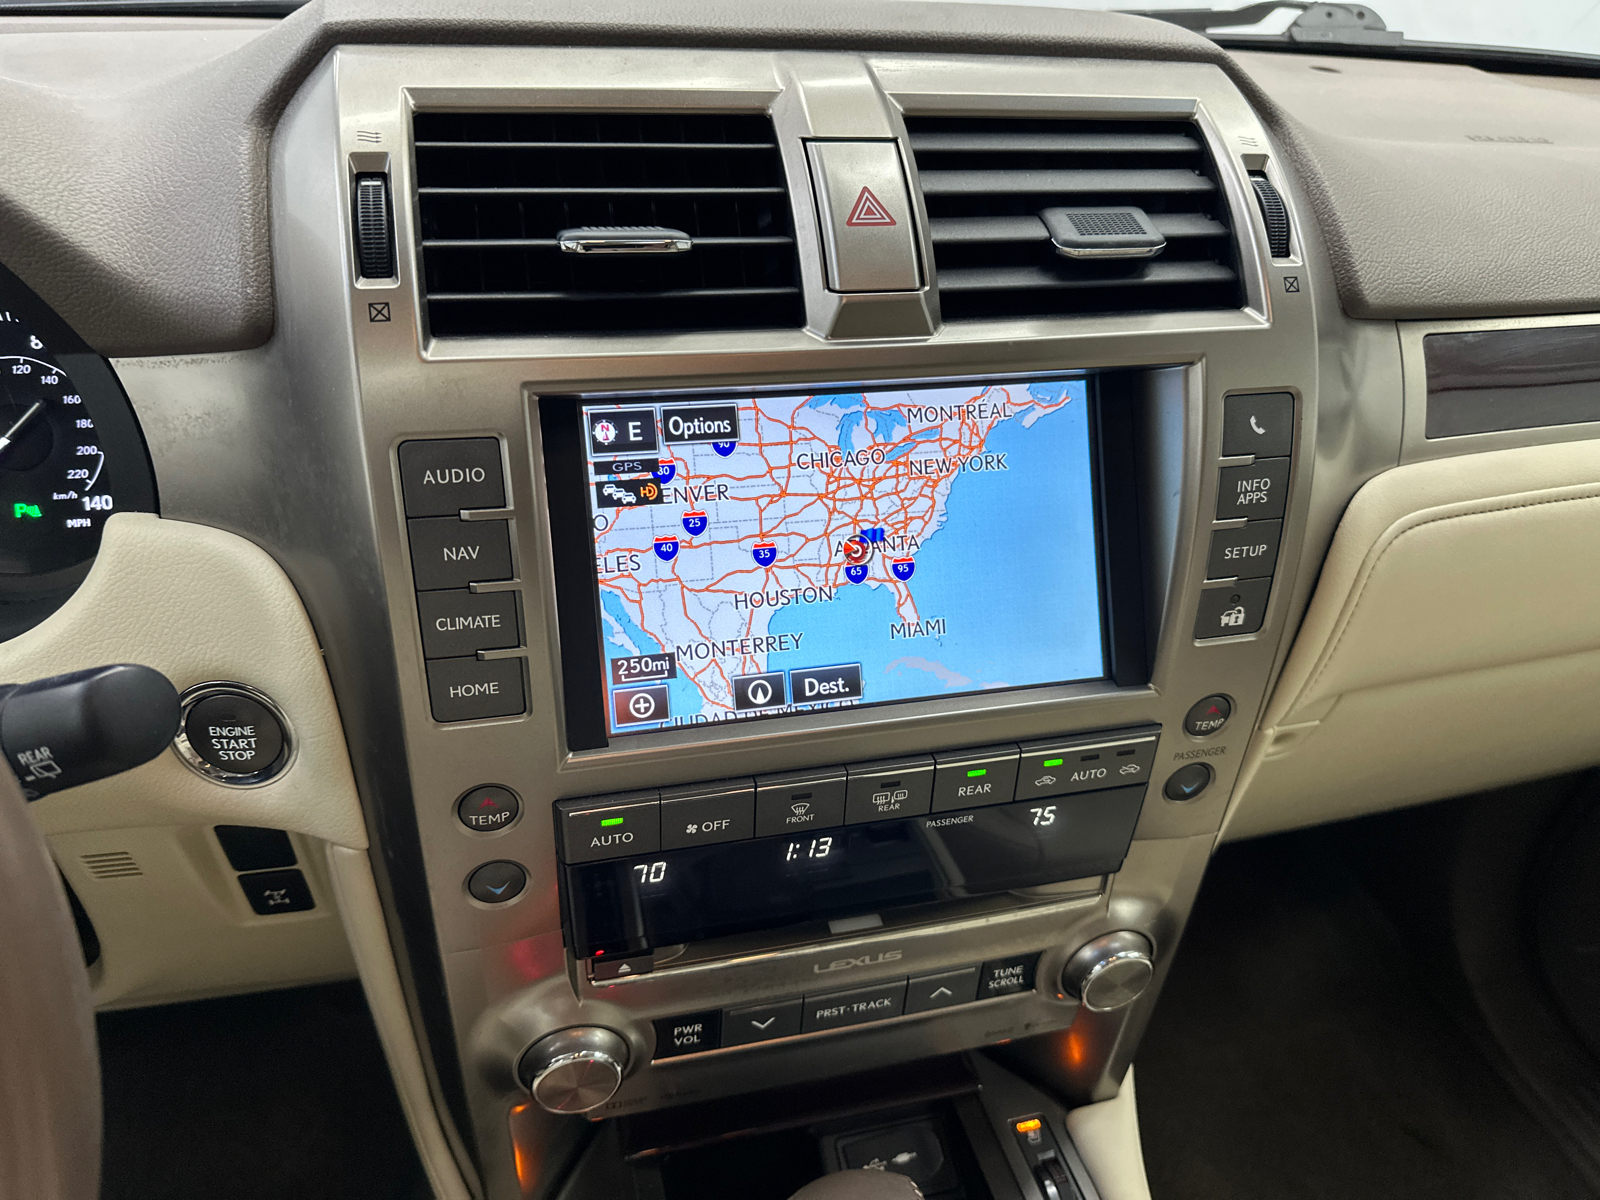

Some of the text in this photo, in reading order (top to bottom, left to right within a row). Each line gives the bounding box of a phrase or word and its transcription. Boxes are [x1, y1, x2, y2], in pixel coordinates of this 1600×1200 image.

[12, 364, 32, 375] 120
[40, 375, 59, 385] 140
[63, 395, 81, 405] 160
[906, 400, 1013, 424] MONTRÉAL
[628, 421, 643, 441] E
[668, 416, 732, 440] Options
[76, 445, 98, 456] 200
[796, 448, 886, 470] CHICAGO
[909, 453, 1009, 476] NEW YORK
[67, 469, 89, 480] 220
[612, 461, 643, 473] GPS
[423, 467, 486, 485] AUDIO
[1237, 477, 1271, 493] INFO
[53, 491, 78, 501] km/h
[662, 483, 730, 505] ENVER
[1236, 491, 1268, 506] APPS
[82, 494, 114, 511] 140
[66, 517, 91, 528] MPH
[688, 517, 701, 527] 25
[443, 545, 480, 561] NAV
[660, 543, 673, 552] 40
[834, 534, 920, 557] AANTA
[1224, 544, 1267, 559] SETUP
[758, 549, 771, 559] 35
[850, 567, 862, 576] 65
[897, 564, 909, 573] 95
[734, 585, 833, 610] HOUSTON
[435, 614, 501, 631] CLIMATE
[890, 618, 946, 639] MIAMI
[676, 632, 803, 661] MONTERREY
[617, 656, 670, 675] 250mi
[449, 682, 500, 698] HOME
[804, 677, 850, 697] Dest.
[208, 726, 256, 737] ENGINE
[1195, 717, 1225, 731] TEMP
[211, 738, 258, 750] START
[17, 746, 54, 766] REAR
[218, 750, 256, 761] STOP
[1173, 746, 1227, 761] PASSENGER
[1070, 768, 1107, 783] AUTO
[957, 783, 992, 797] REAR
[878, 803, 901, 812] REAR
[469, 811, 511, 826] TEMP
[786, 813, 815, 824] FRONT
[926, 815, 974, 828] PASSENGER
[1030, 806, 1057, 826] 75
[701, 819, 731, 832] OFF
[590, 832, 635, 848] AUTO
[785, 836, 833, 862] 1:13
[633, 861, 667, 883] 70
[813, 949, 903, 974] LEXUS
[993, 965, 1024, 978] TUNE
[988, 975, 1024, 989] SCROLL
[673, 1023, 703, 1037] PWR
[673, 1035, 702, 1046] VOL
